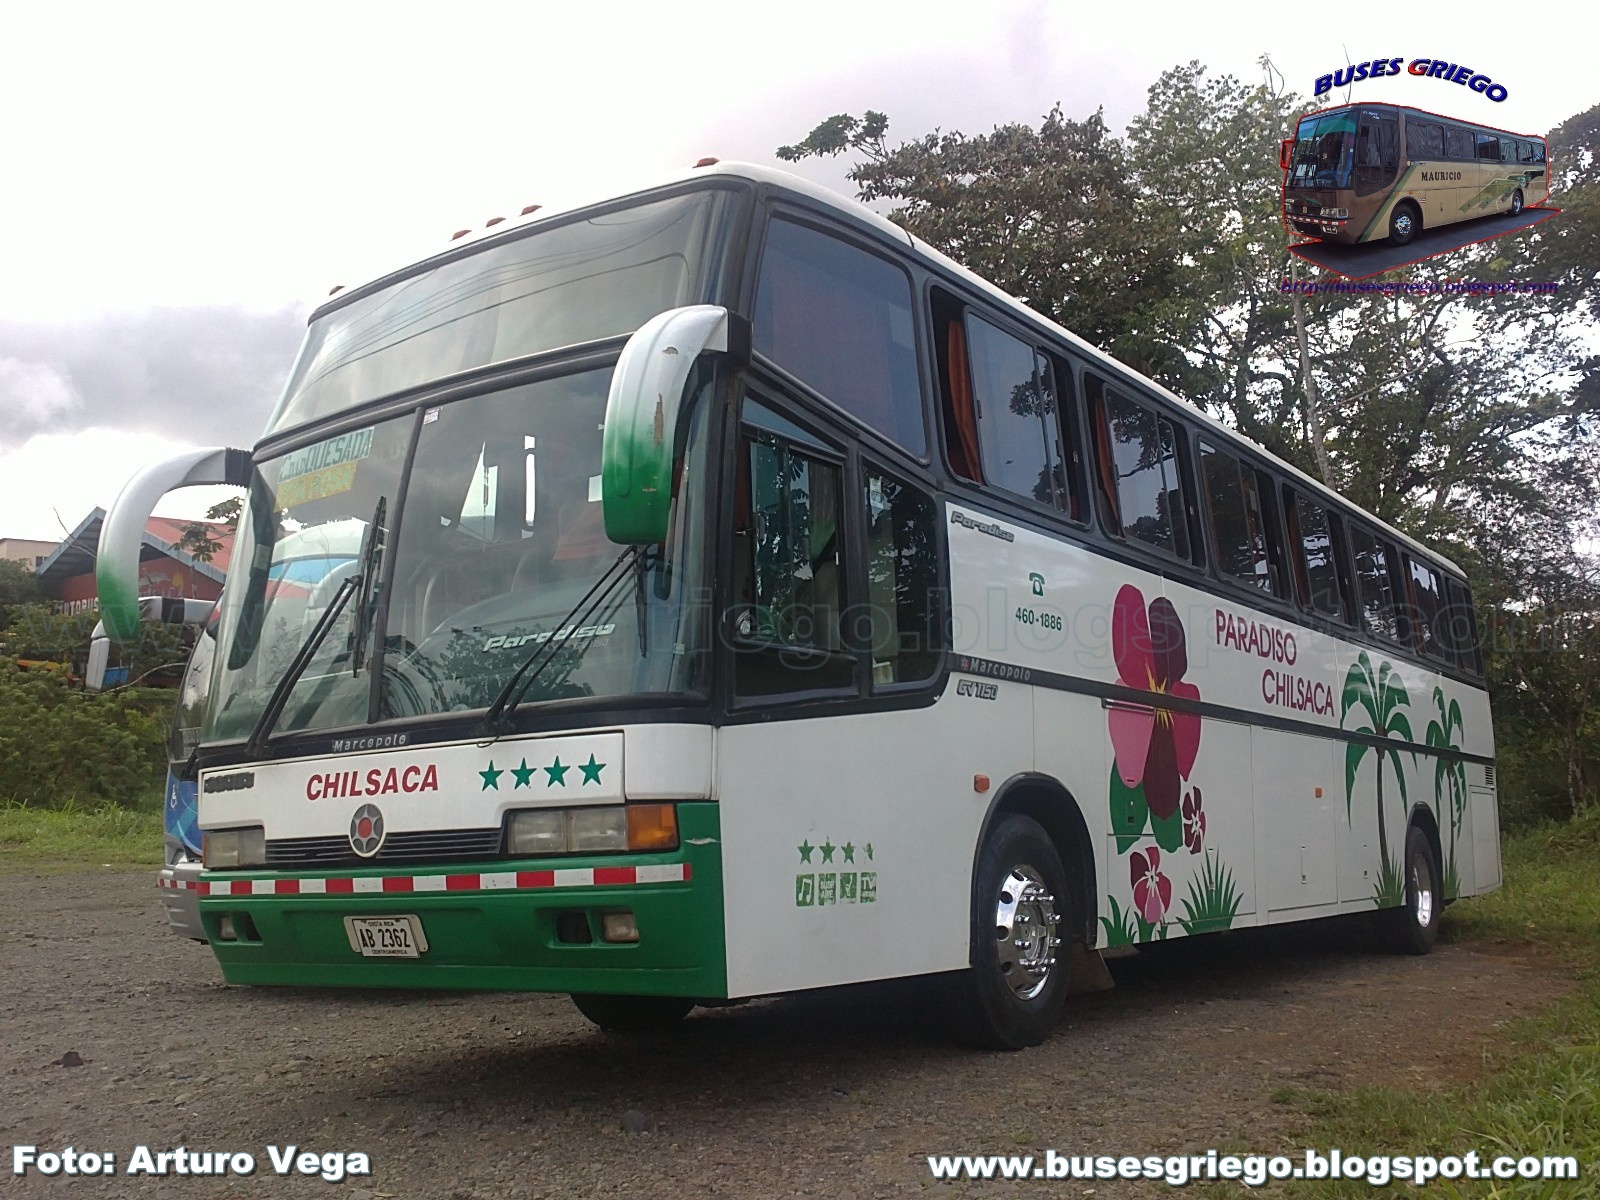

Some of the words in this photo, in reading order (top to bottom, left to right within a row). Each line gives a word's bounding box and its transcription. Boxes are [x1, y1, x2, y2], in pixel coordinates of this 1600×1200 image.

[951, 510, 1015, 542] Paradiso
[1015, 606, 1063, 631] 460-1886
[482, 623, 616, 652] Paradiso
[1215, 608, 1297, 666] PARADISO
[970, 658, 1031, 682] Marcopolo
[1262, 668, 1335, 717] CHILSACA
[332, 734, 407, 752] Marcopolo
[306, 764, 439, 801] CHILSACA
[359, 928, 376, 948] AB
[377, 928, 411, 948] 2362
